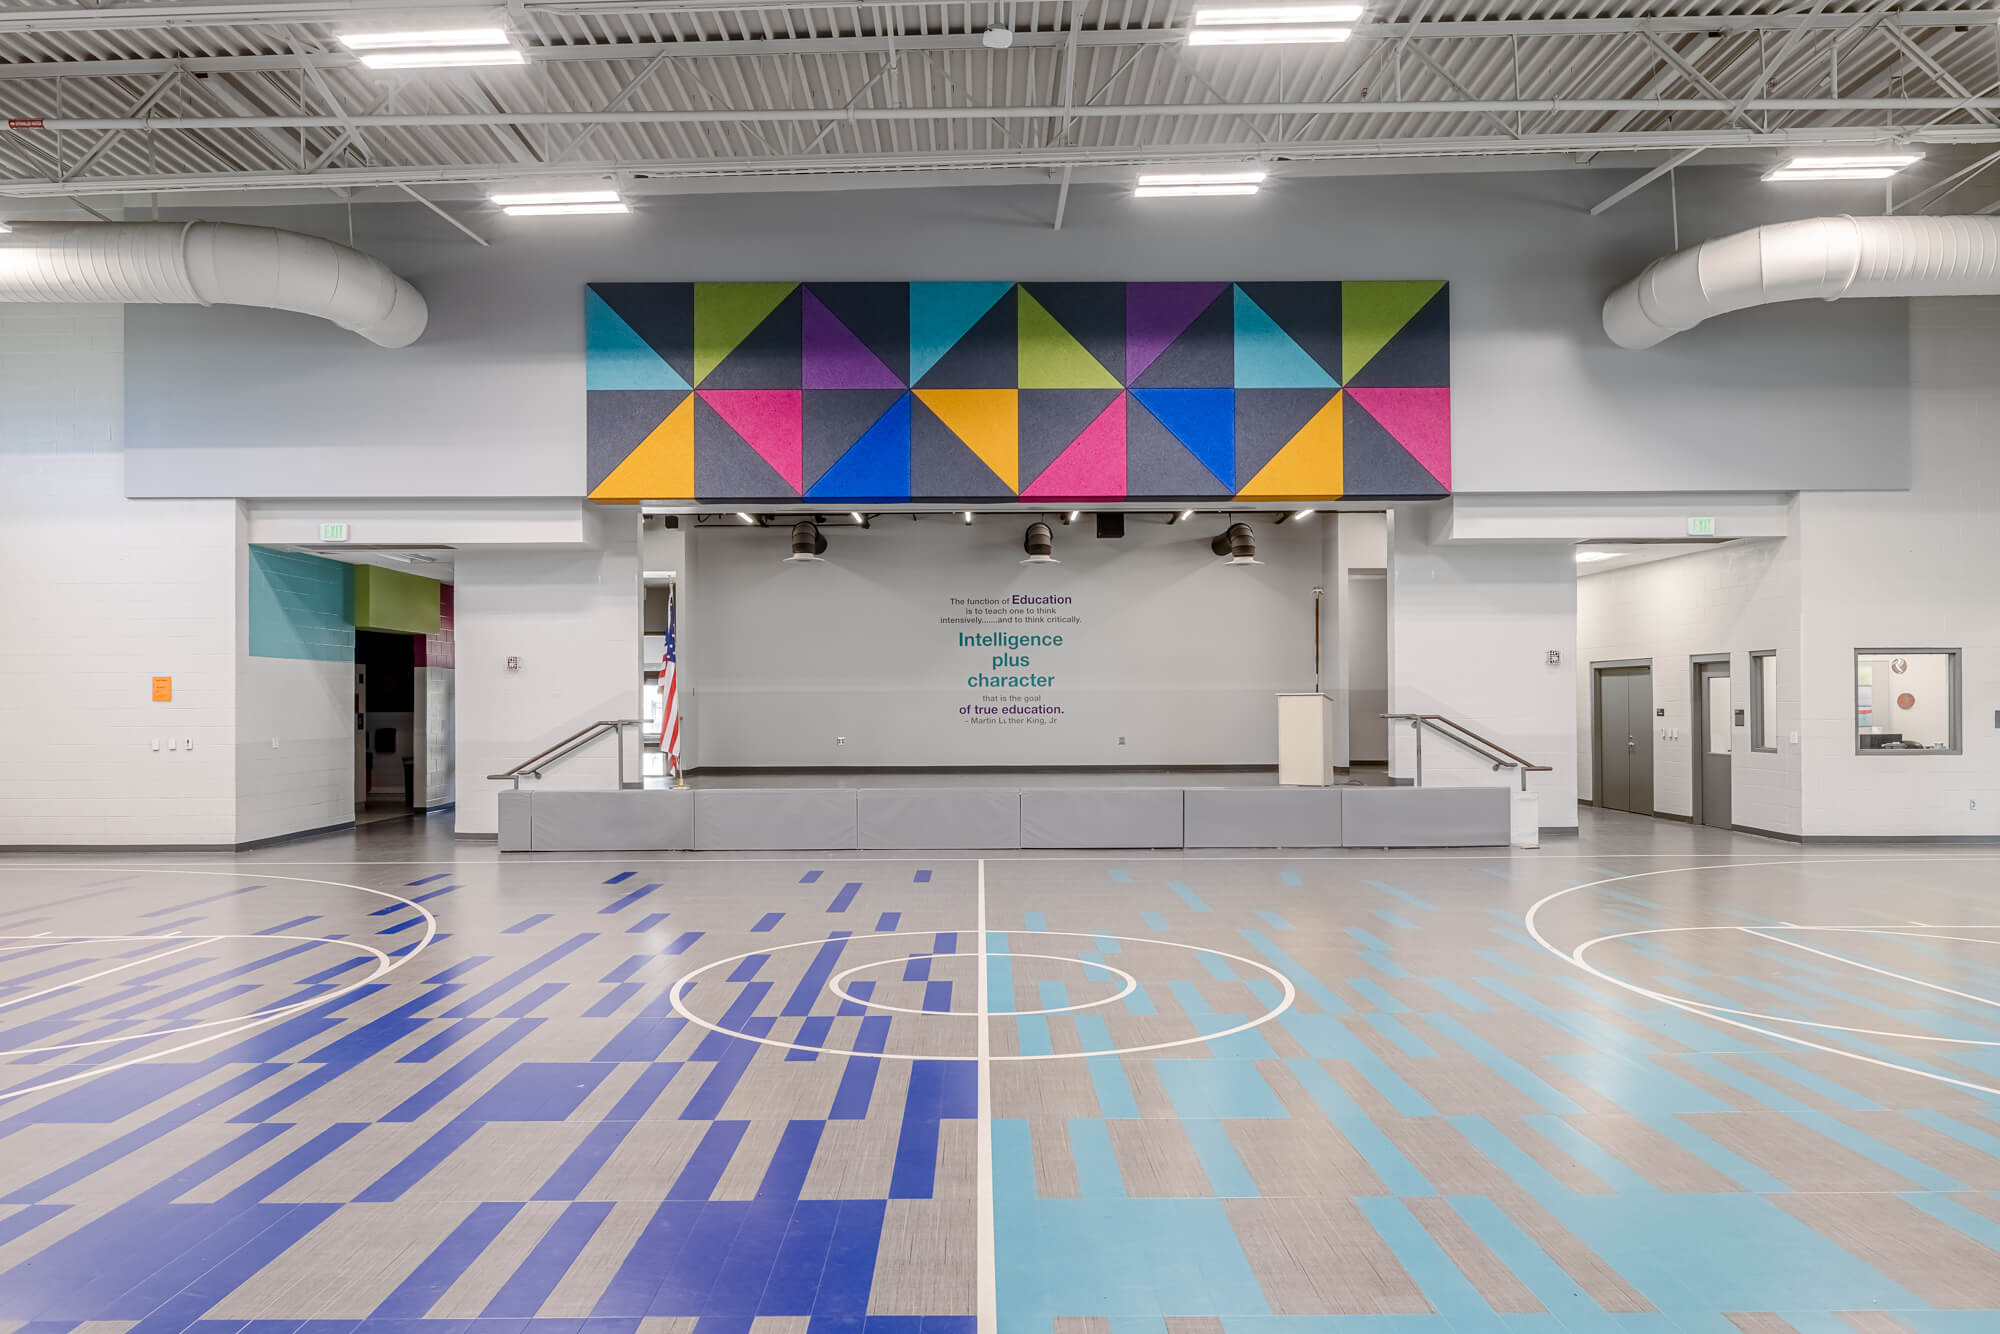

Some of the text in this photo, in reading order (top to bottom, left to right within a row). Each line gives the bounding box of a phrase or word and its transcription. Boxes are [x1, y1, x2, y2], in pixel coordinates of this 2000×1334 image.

[950, 595, 1072, 606] The function of Education
[1047, 616, 1082, 624] critically.
[959, 632, 1063, 649] Intelligence
[992, 653, 1030, 670] plus
[967, 673, 1055, 687] character
[1024, 695, 1041, 703] goal
[959, 705, 1064, 714] of true education.
[971, 717, 996, 725] Martin
[1027, 717, 1047, 725] King,
